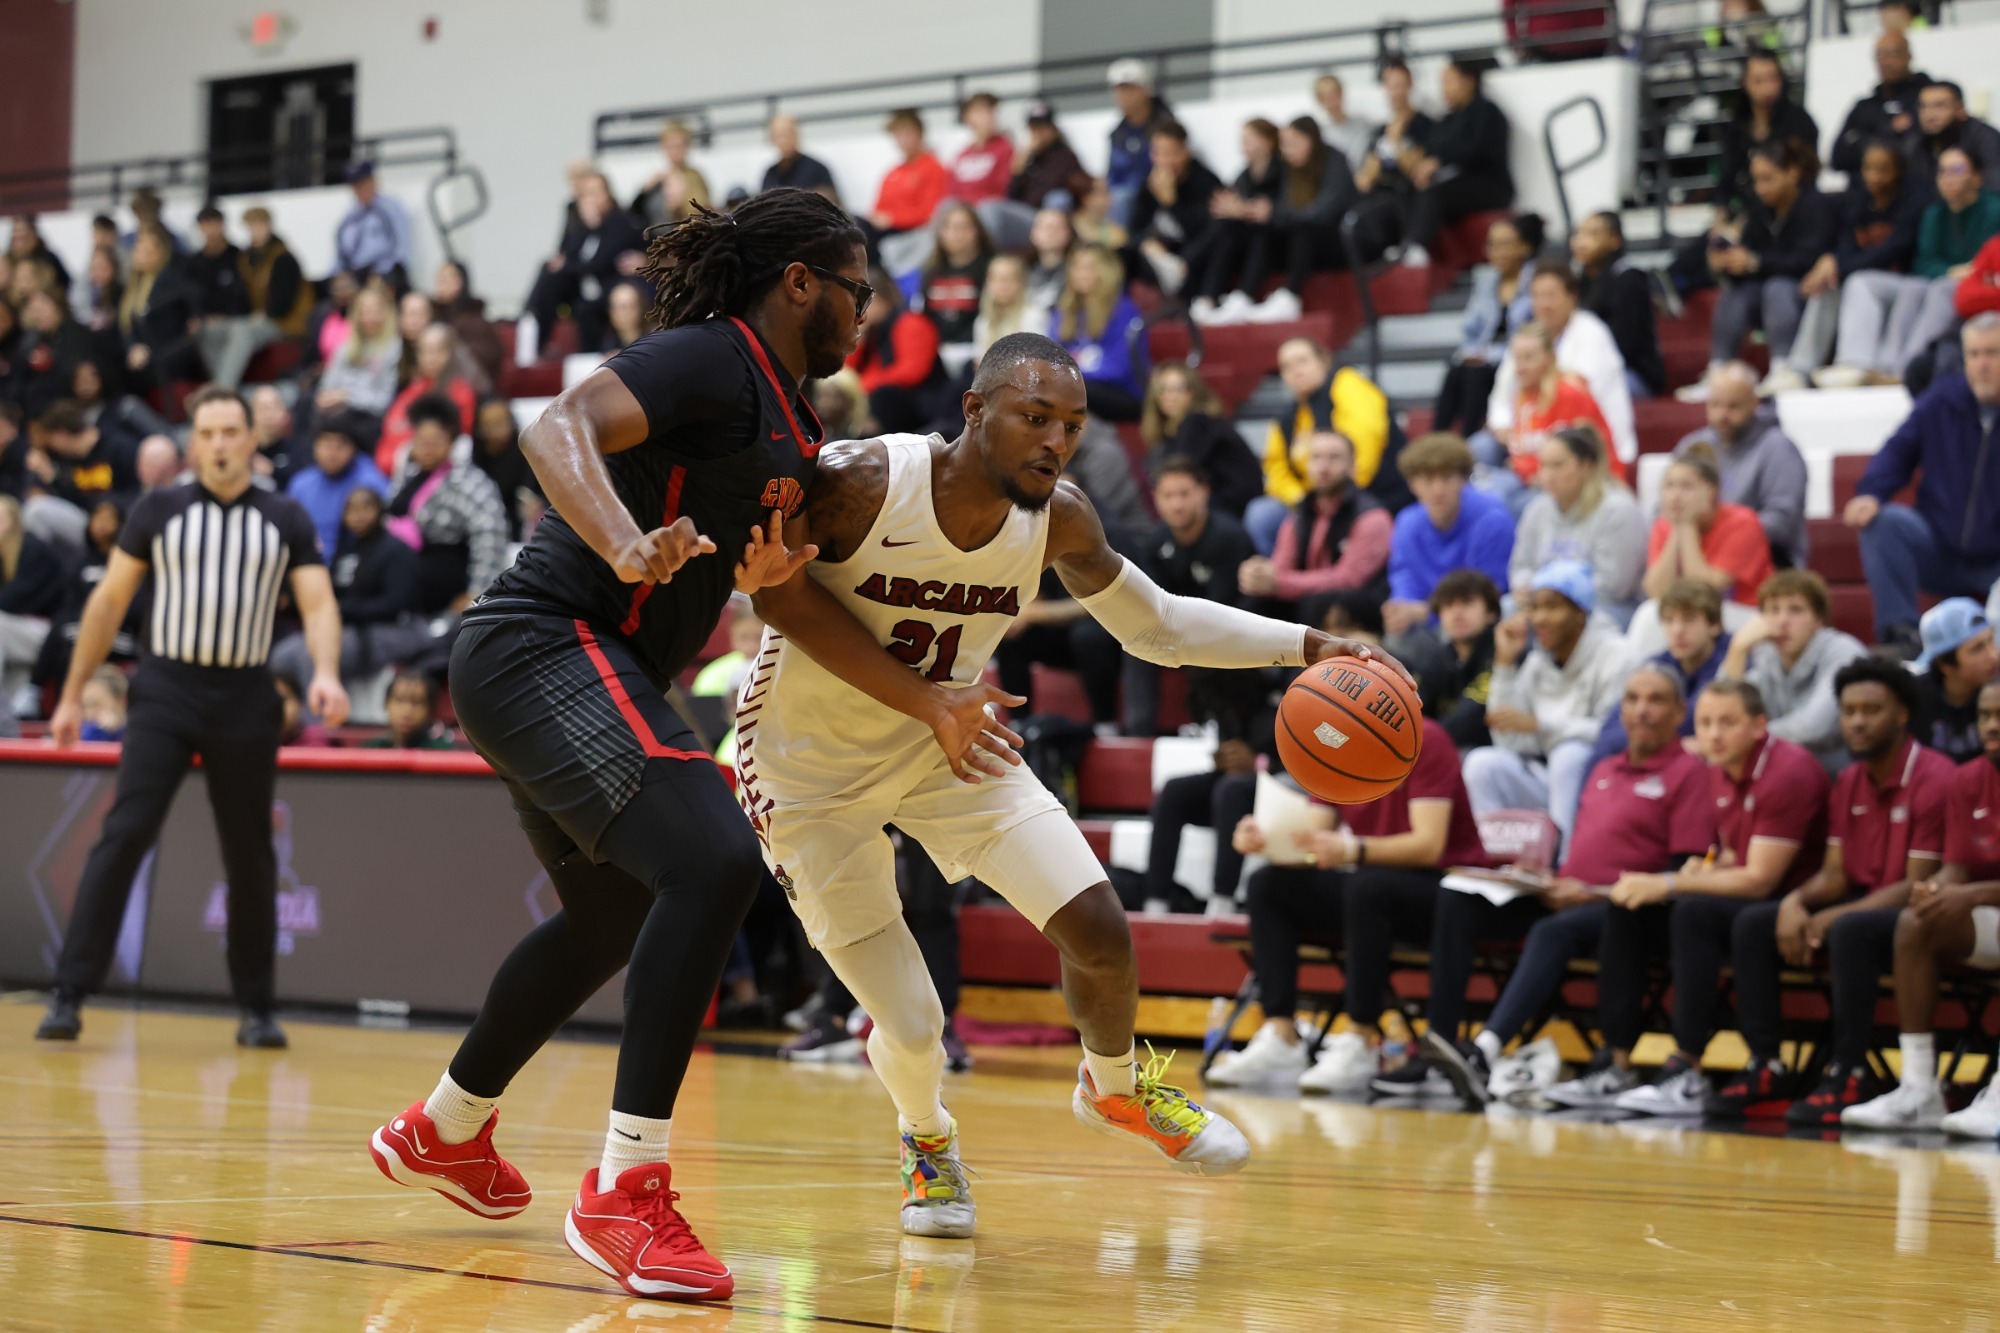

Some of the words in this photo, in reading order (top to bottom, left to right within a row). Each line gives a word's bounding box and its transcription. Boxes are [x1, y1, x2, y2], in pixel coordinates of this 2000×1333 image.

[854, 573, 1020, 616] ARCADIA
[885, 619, 964, 682] 21
[1320, 666, 1372, 701] ROCK
[1366, 688, 1405, 732] THE
